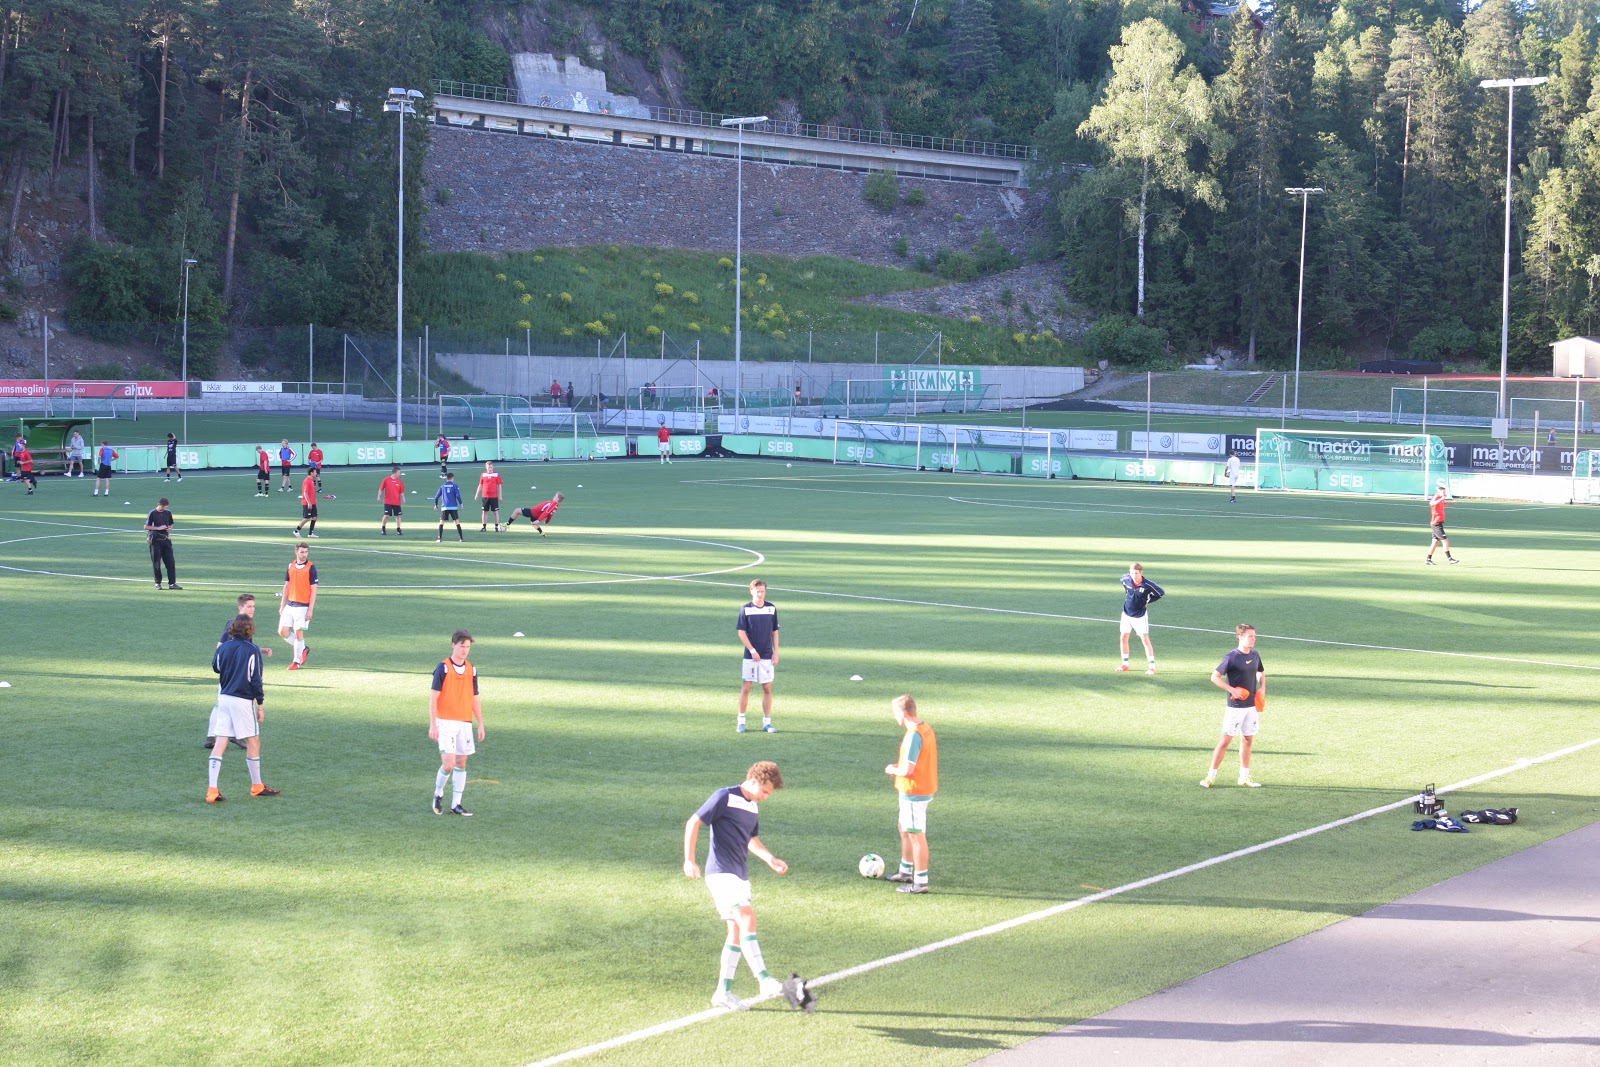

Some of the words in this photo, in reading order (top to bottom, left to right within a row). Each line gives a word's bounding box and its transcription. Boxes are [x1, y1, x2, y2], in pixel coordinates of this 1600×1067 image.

[206, 383, 222, 391] isklar
[232, 383, 247, 391] isklar
[258, 384, 275, 392] isklar
[449, 445, 470, 458] EB
[521, 443, 547, 456] SEB
[595, 442, 620, 453] SEB
[679, 440, 702, 451] SEB
[767, 441, 793, 453] SEB
[1308, 440, 1370, 455] macron
[176, 451, 199, 465] EB
[357, 447, 386, 460] SEB
[846, 446, 874, 459] SEB
[931, 452, 960, 466] SEB
[1473, 446, 1541, 462] macron
[1031, 459, 1061, 472] SEB
[1124, 463, 1157, 477] SEB
[1328, 473, 1364, 488] SEB
